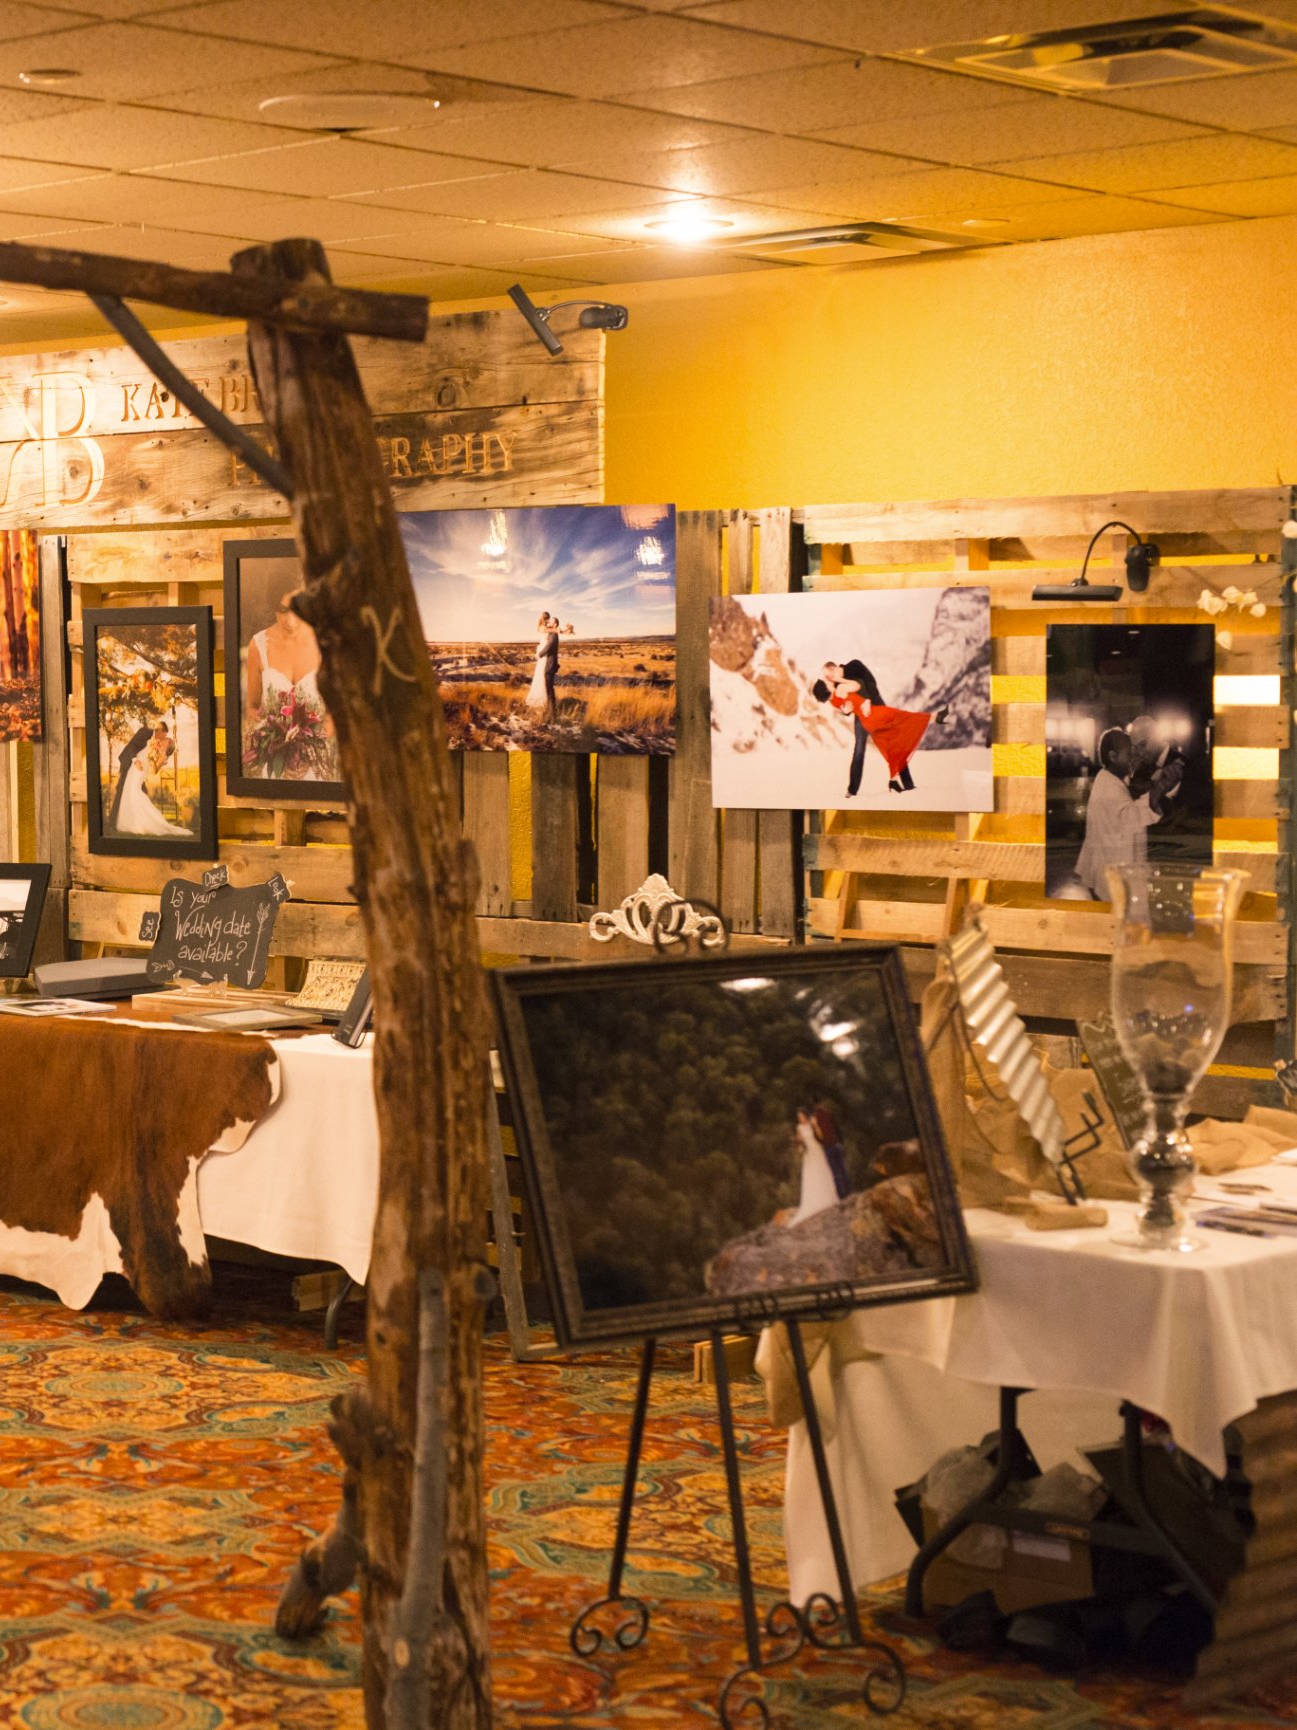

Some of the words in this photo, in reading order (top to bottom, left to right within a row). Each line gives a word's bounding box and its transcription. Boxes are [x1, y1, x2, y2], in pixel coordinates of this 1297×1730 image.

[170, 886, 184, 908] Is
[190, 891, 217, 910] your
[223, 909, 251, 938] date
